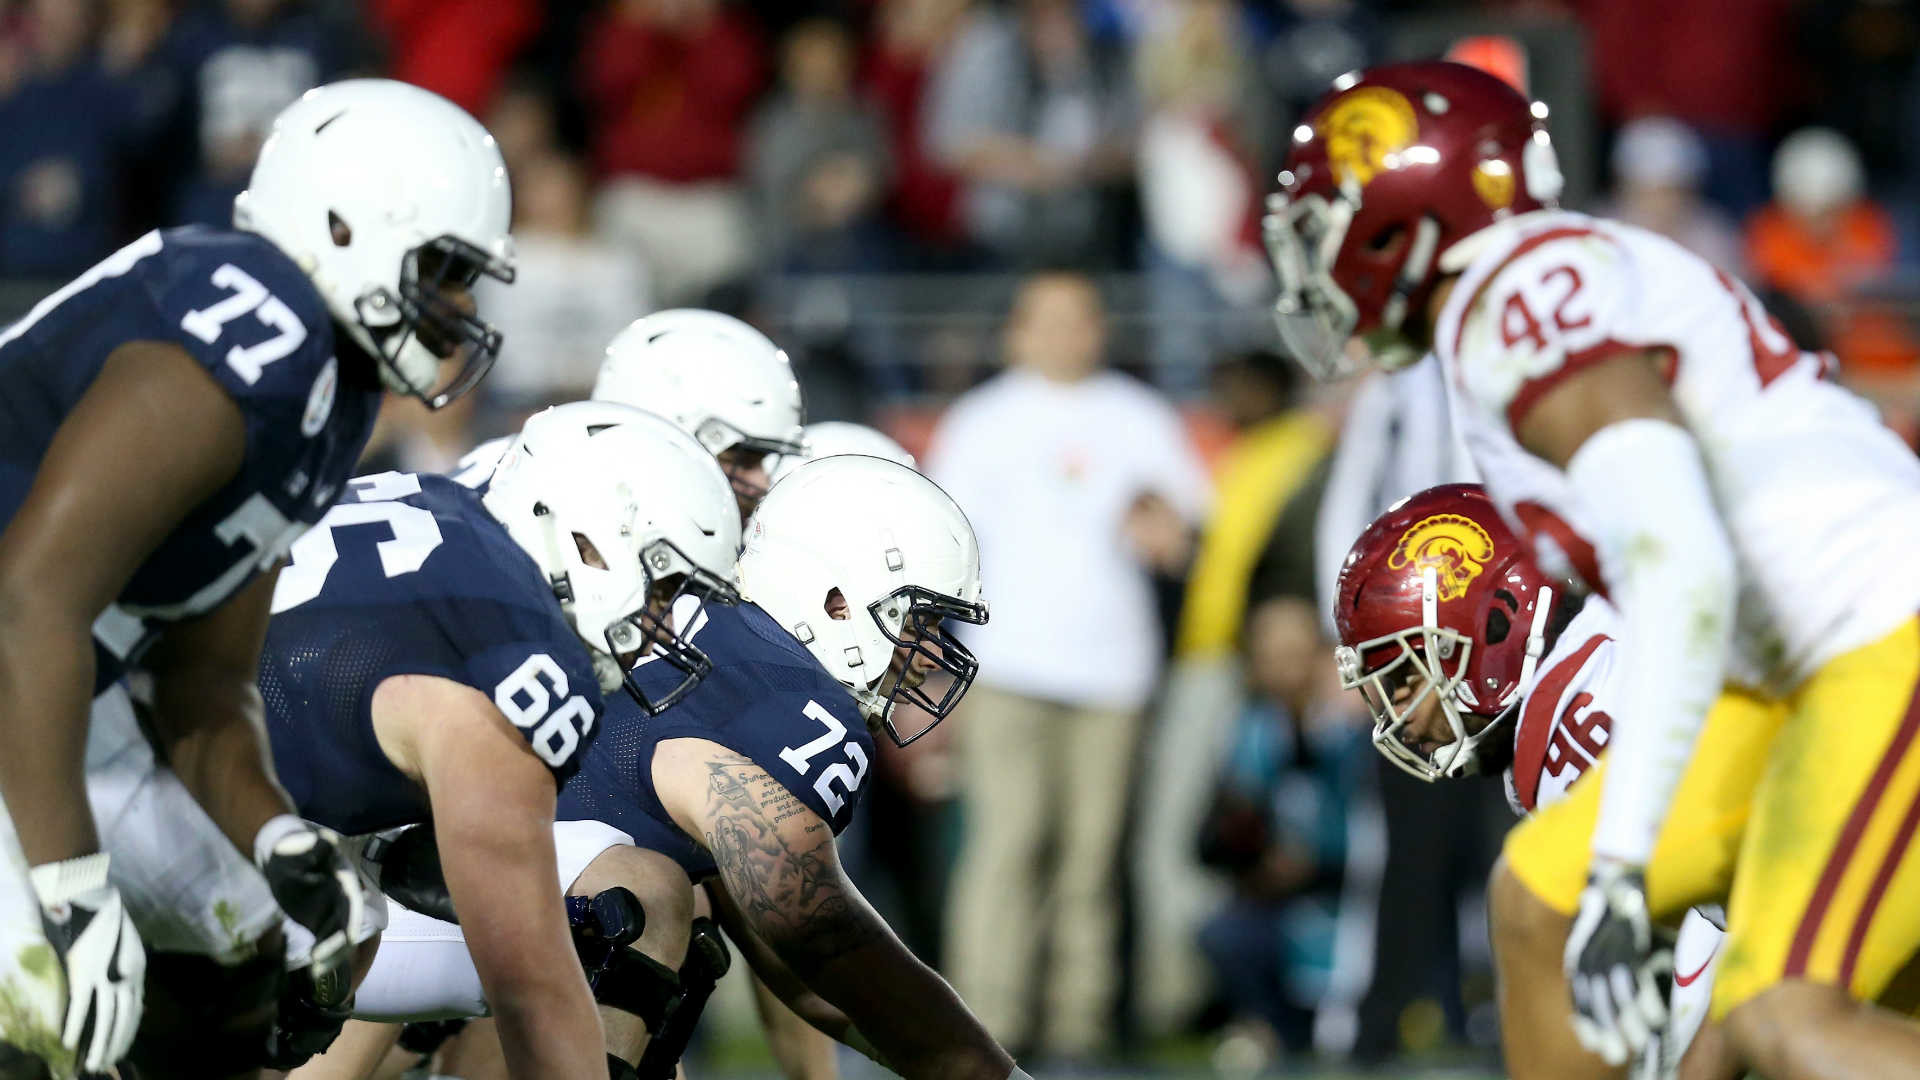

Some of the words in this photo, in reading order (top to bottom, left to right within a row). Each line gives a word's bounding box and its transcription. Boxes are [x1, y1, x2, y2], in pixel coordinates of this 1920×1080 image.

[181, 262, 308, 387] 77
[1502, 264, 1592, 352] 42
[495, 653, 596, 767] 66
[778, 699, 869, 818] 72
[1543, 691, 1614, 793] 96
